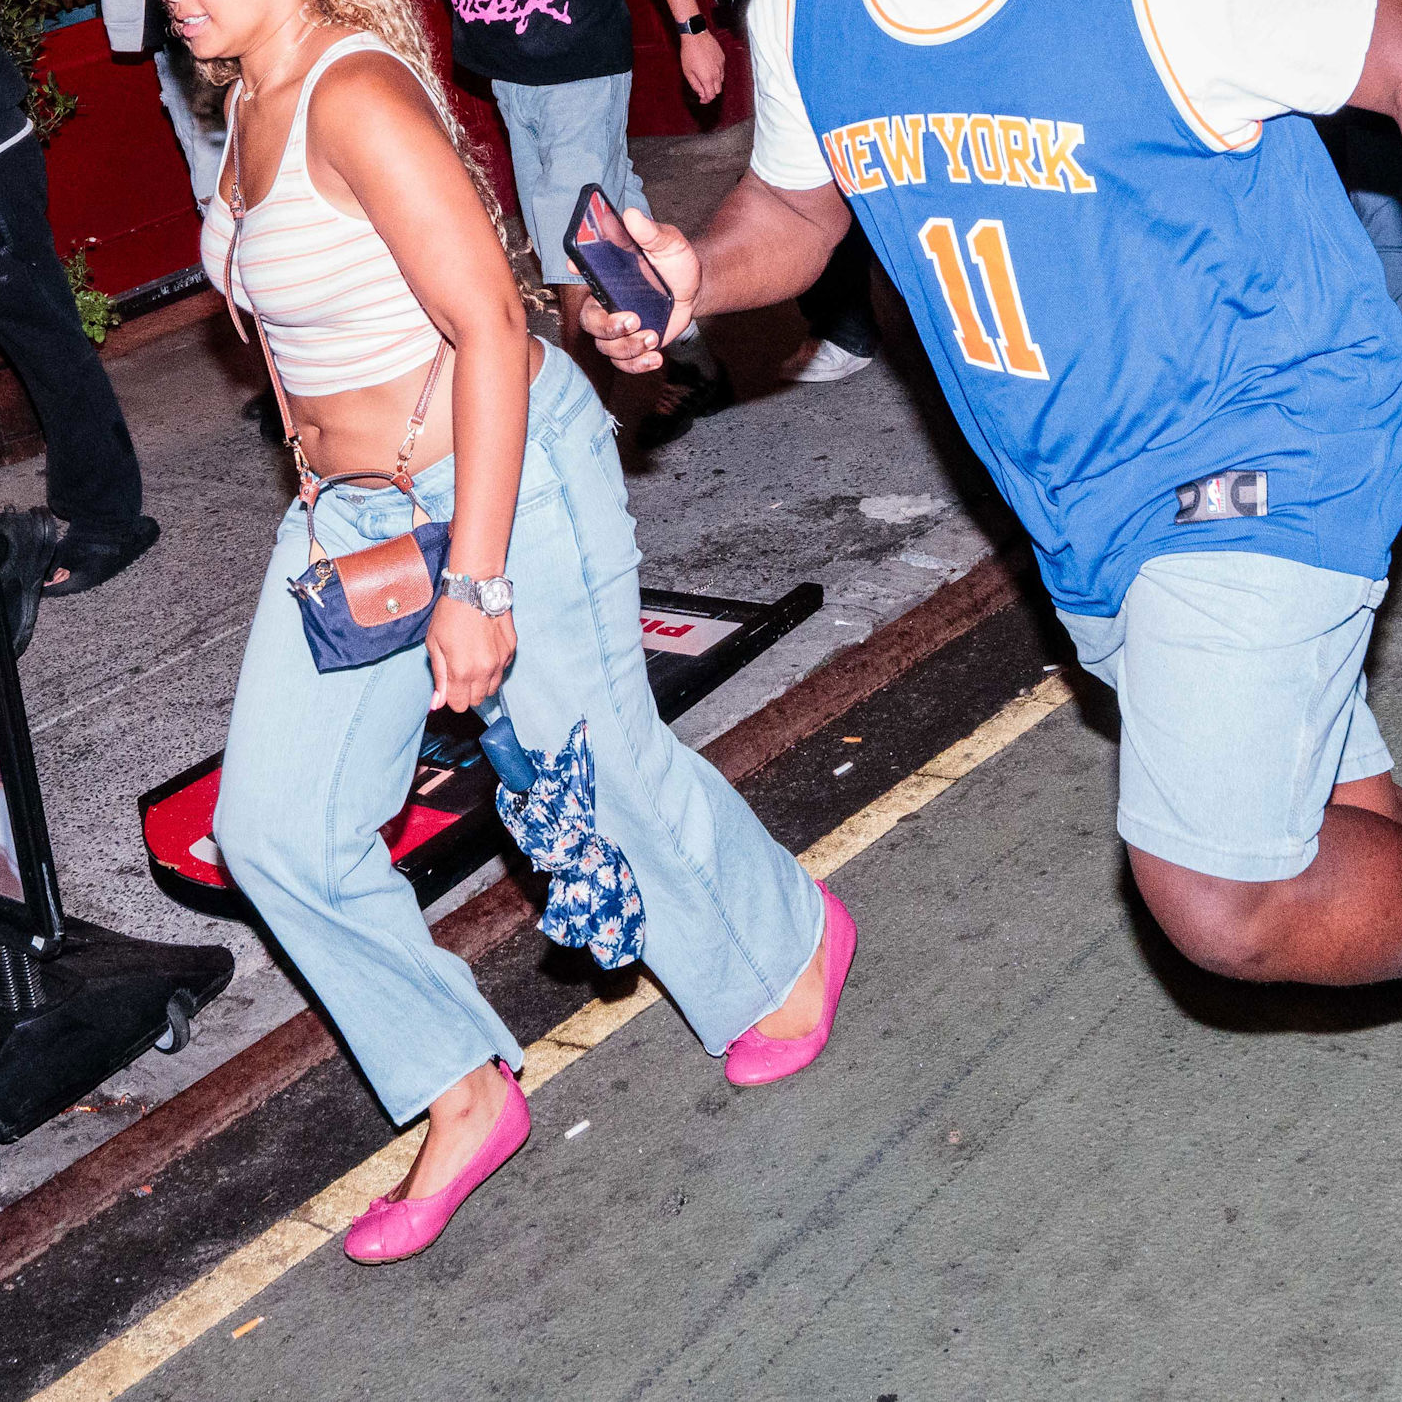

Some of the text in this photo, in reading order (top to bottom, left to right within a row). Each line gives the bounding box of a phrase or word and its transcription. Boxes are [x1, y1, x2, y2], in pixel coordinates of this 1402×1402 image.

[822, 113, 1098, 197] NEW YORK
[917, 217, 1051, 381] 11
